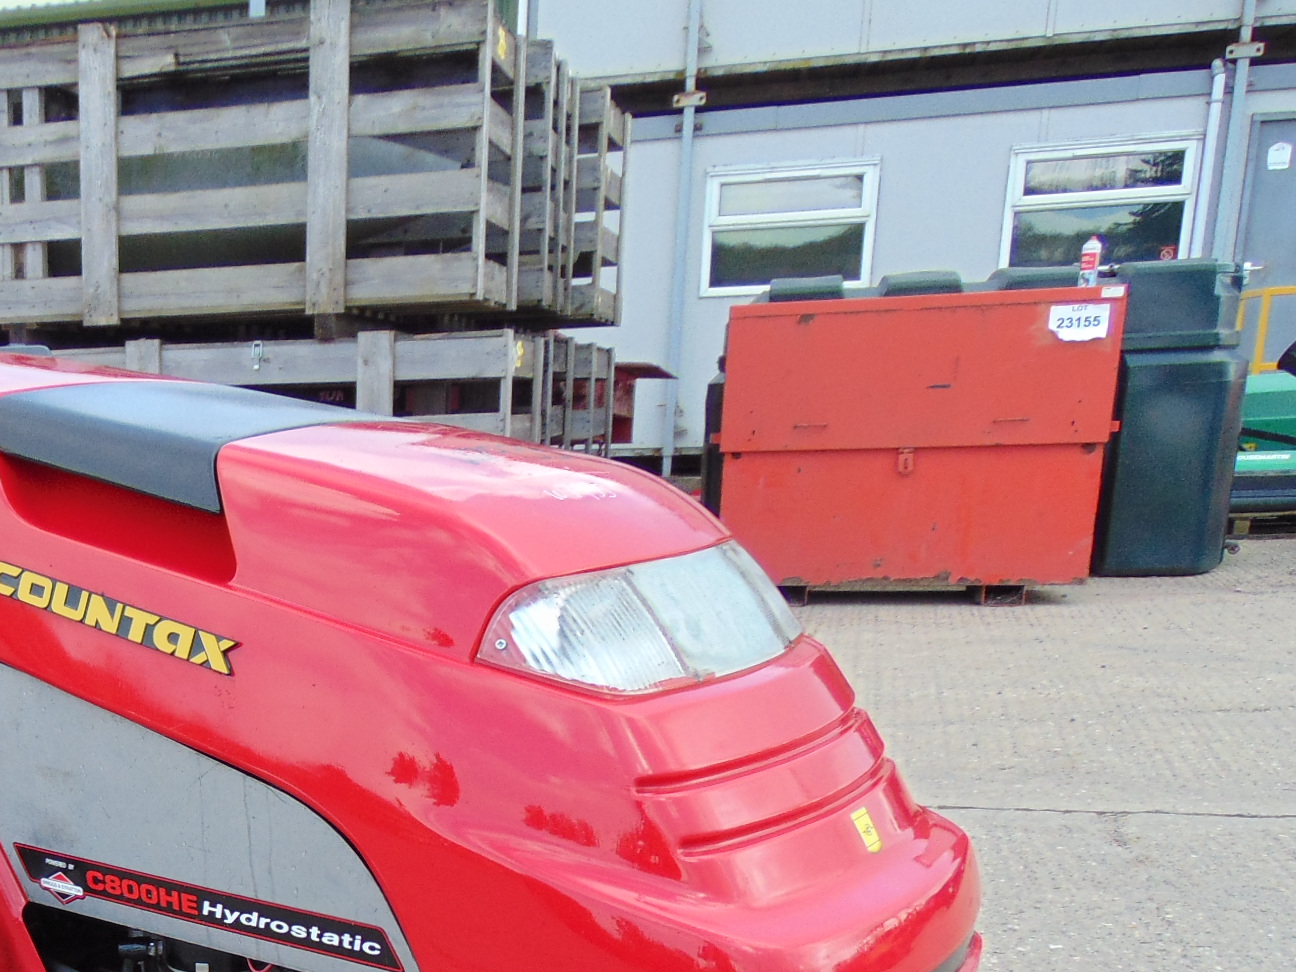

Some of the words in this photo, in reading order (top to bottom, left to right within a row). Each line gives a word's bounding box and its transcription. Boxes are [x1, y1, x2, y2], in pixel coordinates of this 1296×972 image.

[1071, 304, 1088, 312] LOT
[1056, 315, 1101, 329] 23155
[85, 870, 200, 916] C800HE
[202, 901, 382, 957] Hydrostatic
